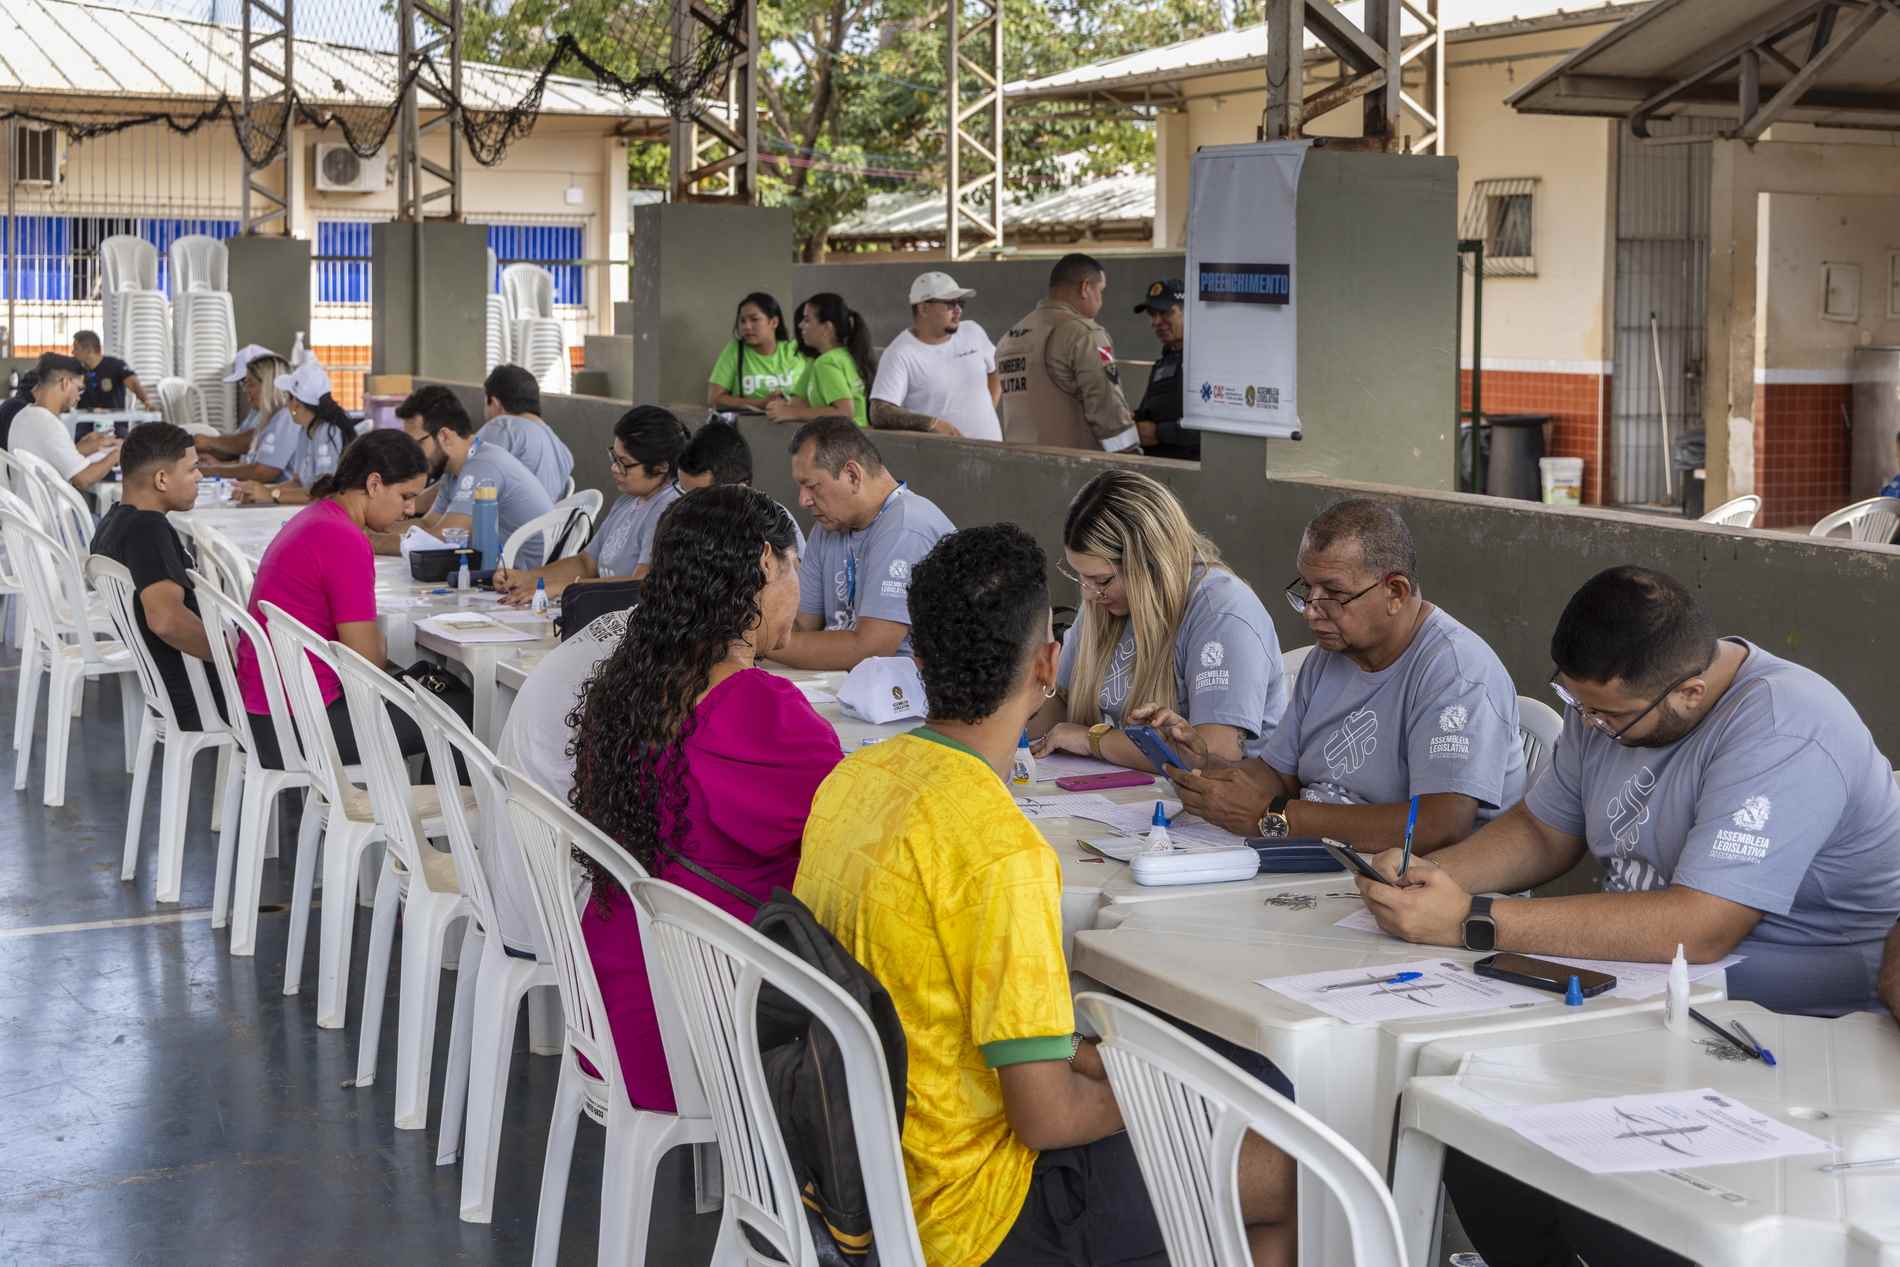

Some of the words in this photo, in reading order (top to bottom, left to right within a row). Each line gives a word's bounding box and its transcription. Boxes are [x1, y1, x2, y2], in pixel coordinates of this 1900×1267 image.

[1200, 271, 1289, 295] PREENCHIMENTO
[1430, 743, 1470, 754] LEGISLATIVA
[1431, 735, 1470, 746] ASSEMBLEIA
[1717, 829, 1769, 848] ASSEMBLEIA
[1713, 839, 1766, 858] LEGISLATIVA
